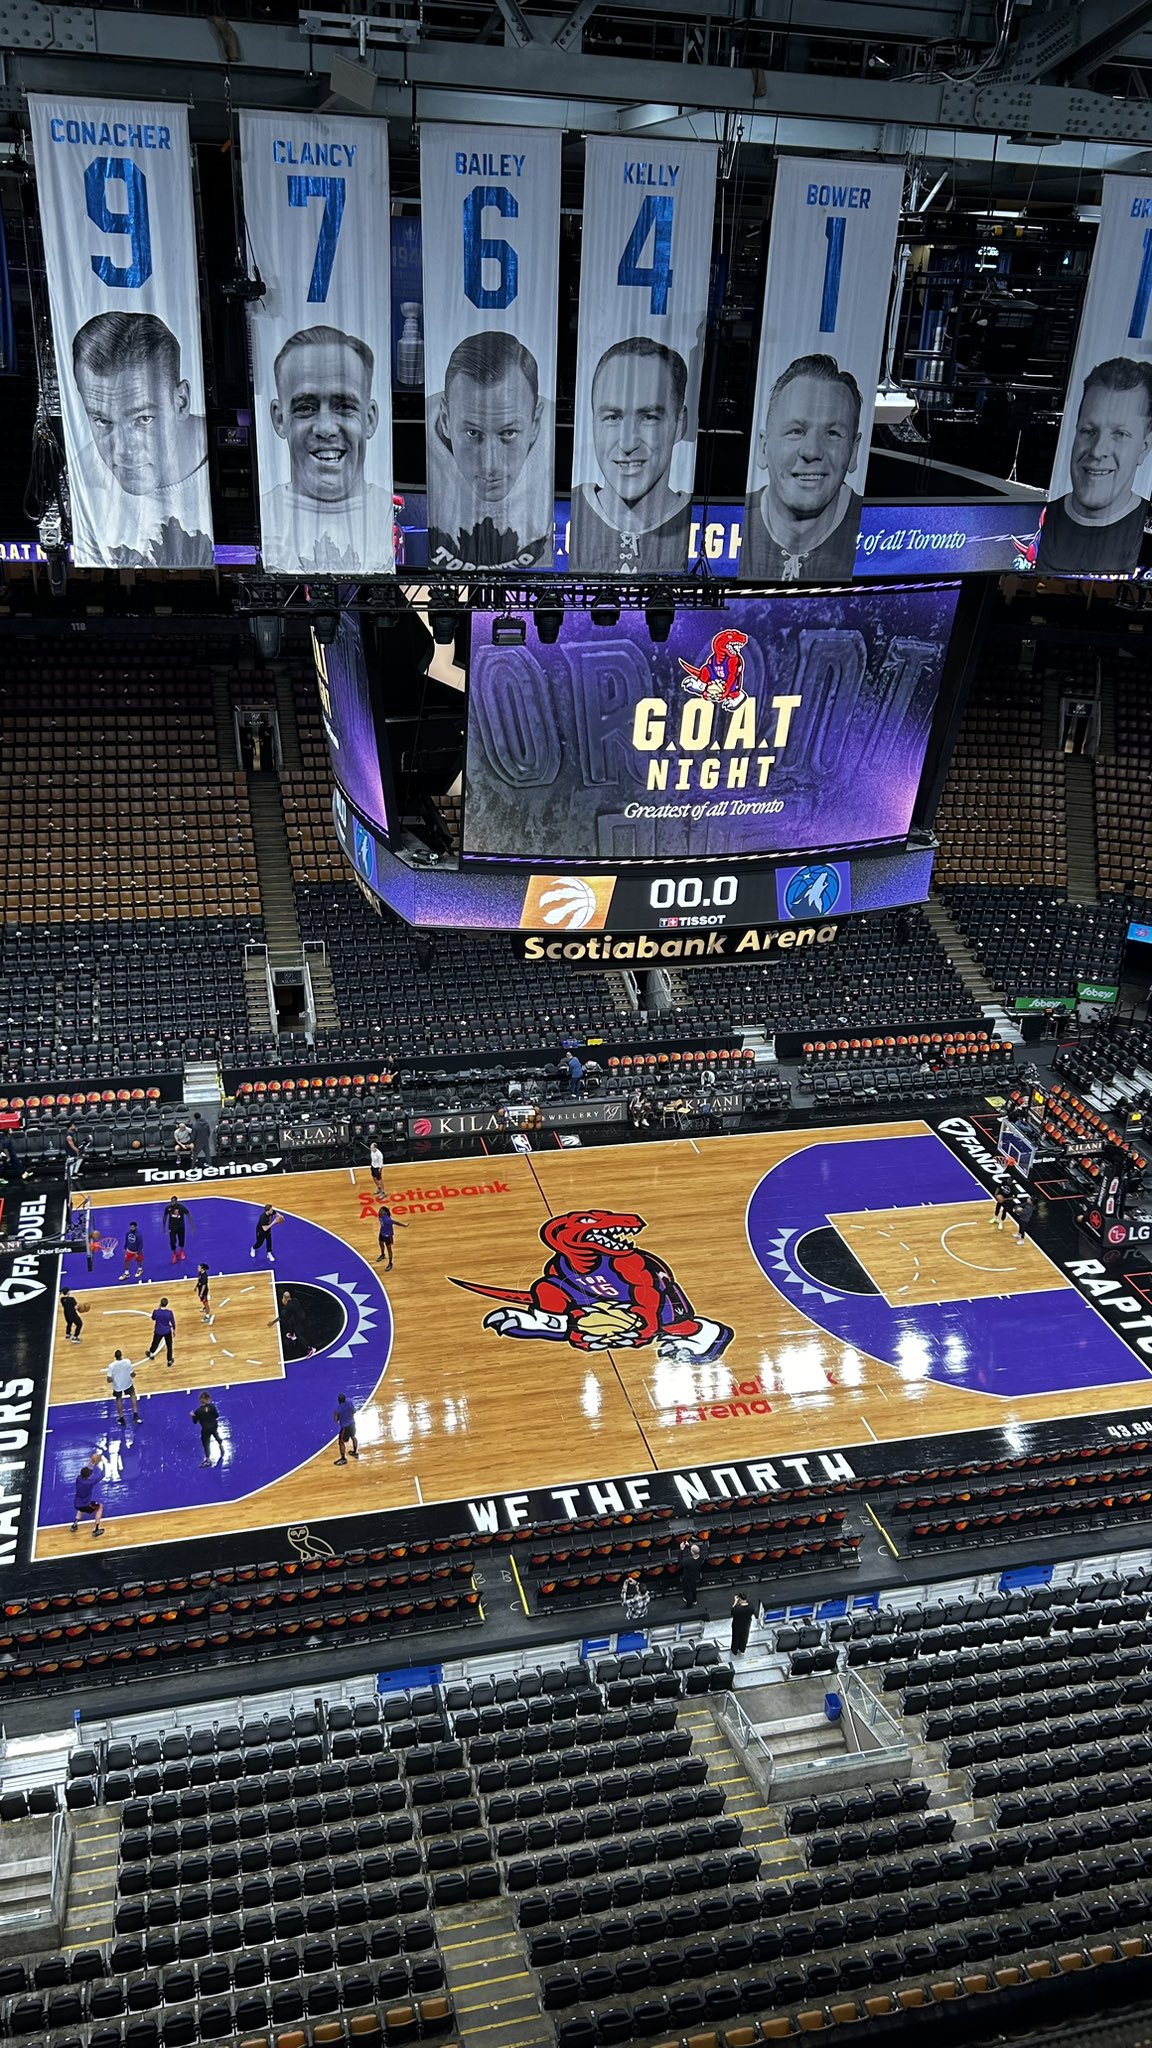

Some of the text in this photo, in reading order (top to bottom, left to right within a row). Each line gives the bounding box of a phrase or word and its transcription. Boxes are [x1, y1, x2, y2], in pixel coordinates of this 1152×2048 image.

[51, 118, 171, 149] CONACHER
[273, 140, 357, 167] CLANCY
[455, 152, 526, 177] BAILEY
[624, 162, 680, 187] KELLY
[806, 184, 872, 209] BOWER
[84, 156, 152, 288] 9
[287, 175, 346, 302] 7
[463, 185, 518, 309] 6
[617, 195, 674, 315] 4
[818, 216, 847, 332] 1
[864, 530, 885, 555] of
[880, 530, 906, 550] all
[907, 529, 966, 550] Toronto
[71, 622, 87, 631] 118
[632, 695, 802, 751] G.O.A.T
[646, 756, 775, 791] NIGHT
[624, 798, 785, 821] Greatest of all Toronto
[650, 875, 739, 909] 00.0
[679, 914, 726, 926] TISSOT
[523, 924, 838, 960] Scotiabank Arena
[1080, 987, 1114, 999] Sobeys
[1067, 1142, 1102, 1152] KILANI
[137, 1161, 268, 1182] Tangerine
[12, 1194, 47, 1277] FADUEL
[1129, 1225, 1150, 1241] LG
[576, 1276, 606, 1285] TOR
[500, 1570, 512, 1582] B
